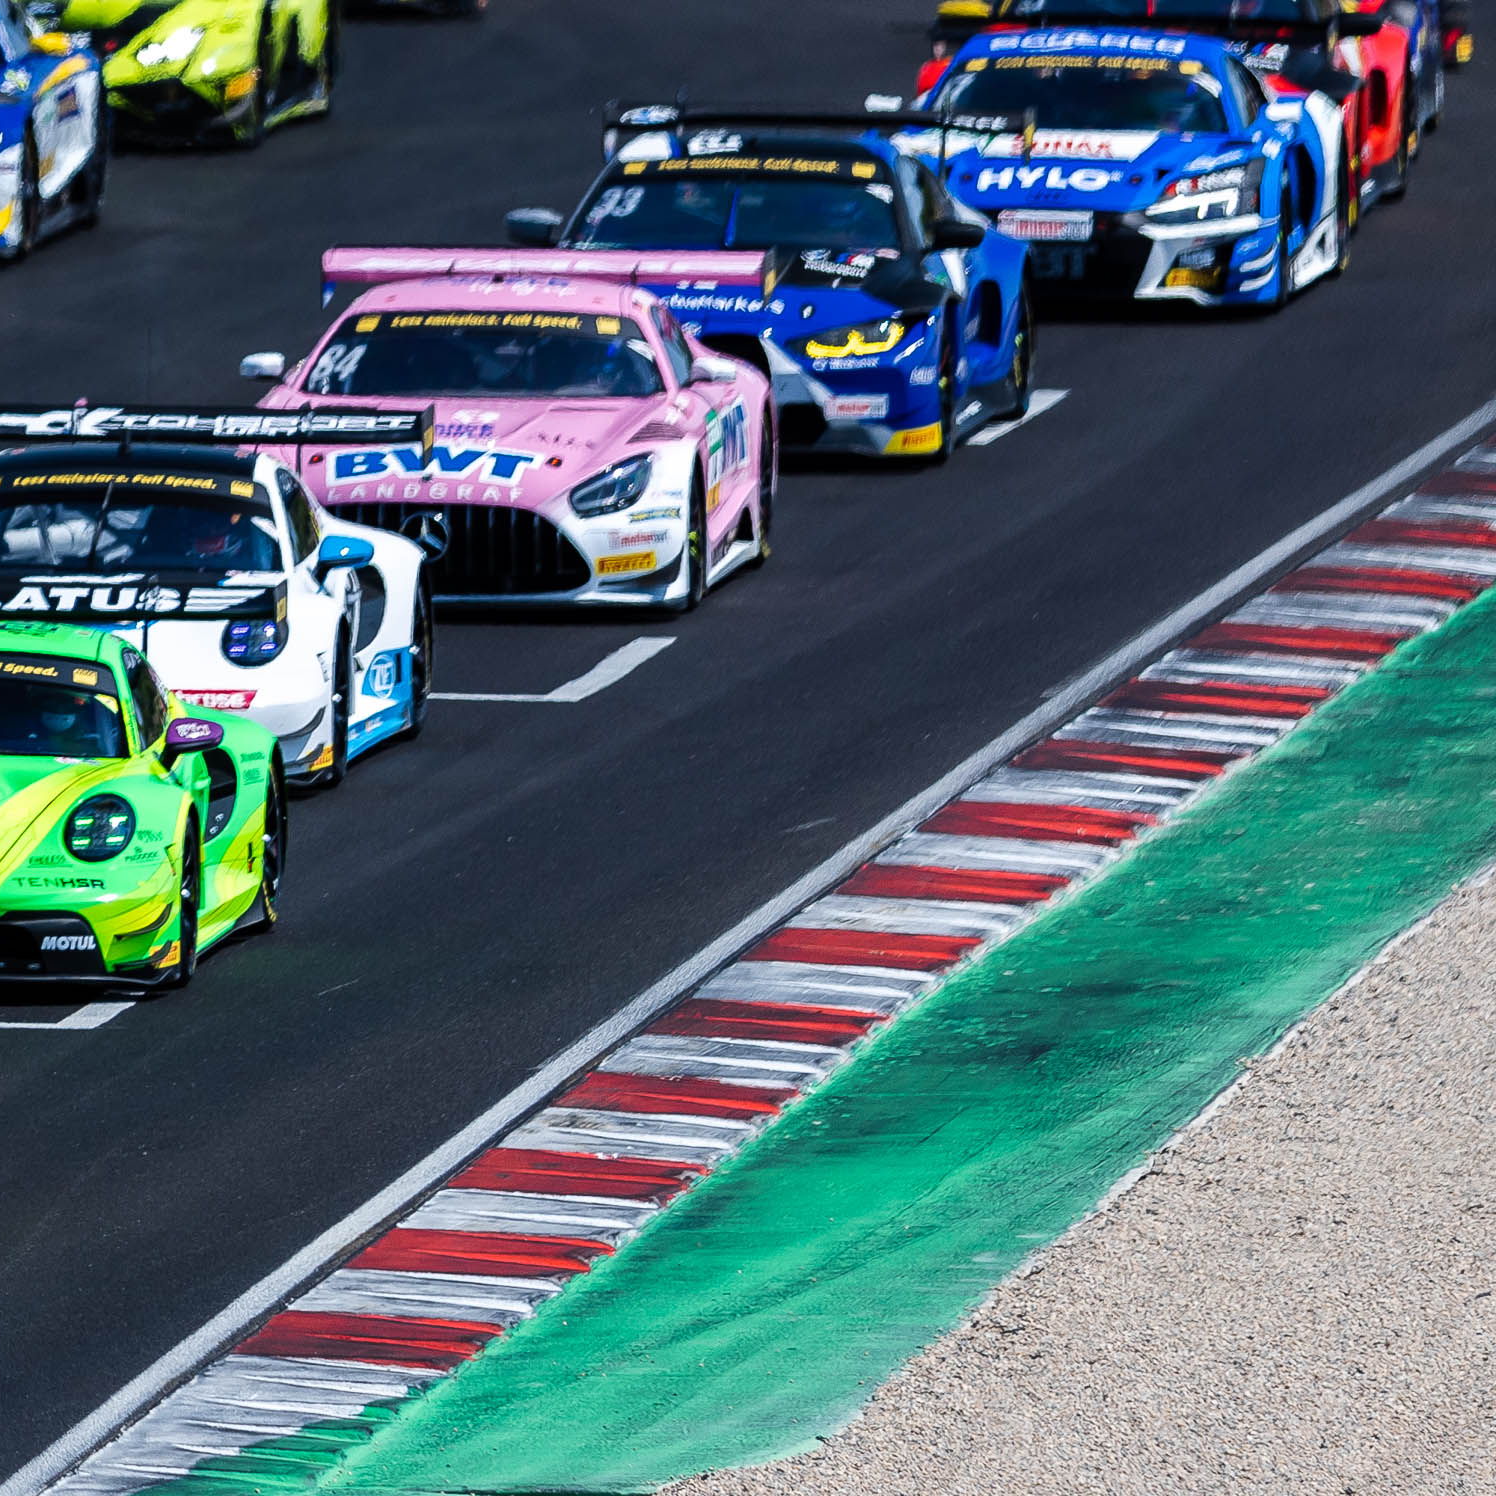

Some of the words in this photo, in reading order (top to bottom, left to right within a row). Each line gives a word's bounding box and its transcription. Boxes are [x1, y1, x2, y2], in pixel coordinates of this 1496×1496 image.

[976, 166, 1111, 192] HYLO
[334, 448, 534, 481] BWT
[328, 485, 524, 502] LANDGRAF
[3, 662, 59, 678] Speed.
[41, 935, 97, 952] MOTUL
